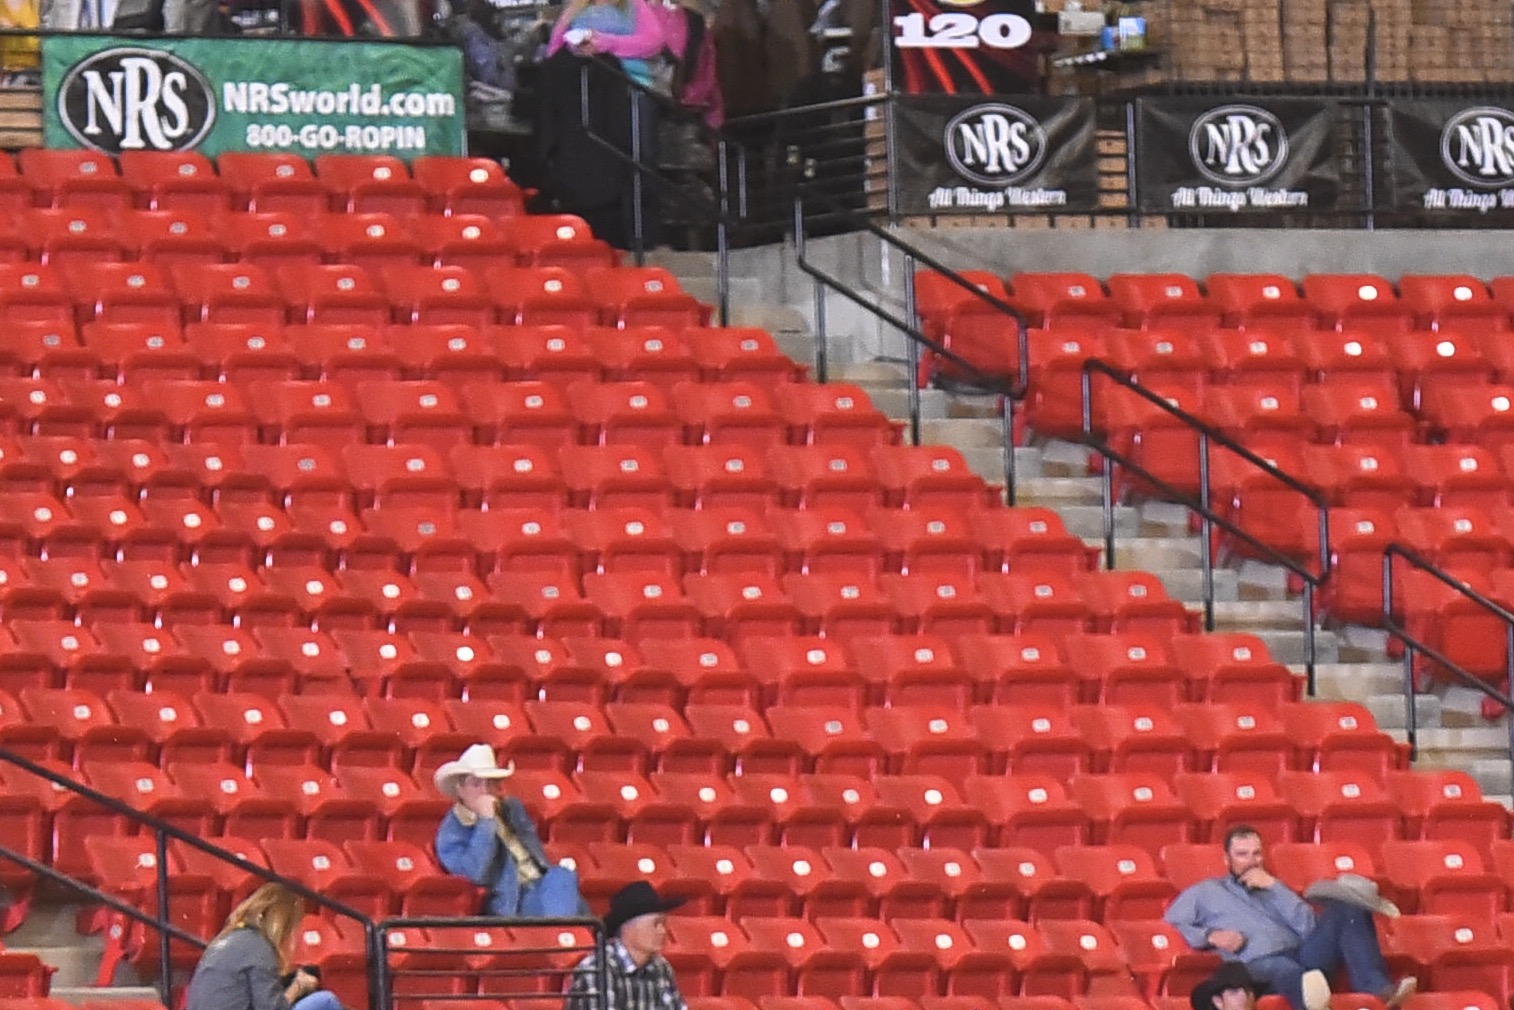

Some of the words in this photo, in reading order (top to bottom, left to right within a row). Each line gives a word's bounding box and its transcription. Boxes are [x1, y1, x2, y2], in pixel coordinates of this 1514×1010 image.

[893, 12, 1032, 48] 120
[82, 57, 188, 149] NRS
[223, 82, 456, 117] NRSworld.com
[245, 124, 426, 149] 800-GO-ROPIN
[958, 113, 1031, 174] NRS
[1205, 115, 1271, 174] NRS
